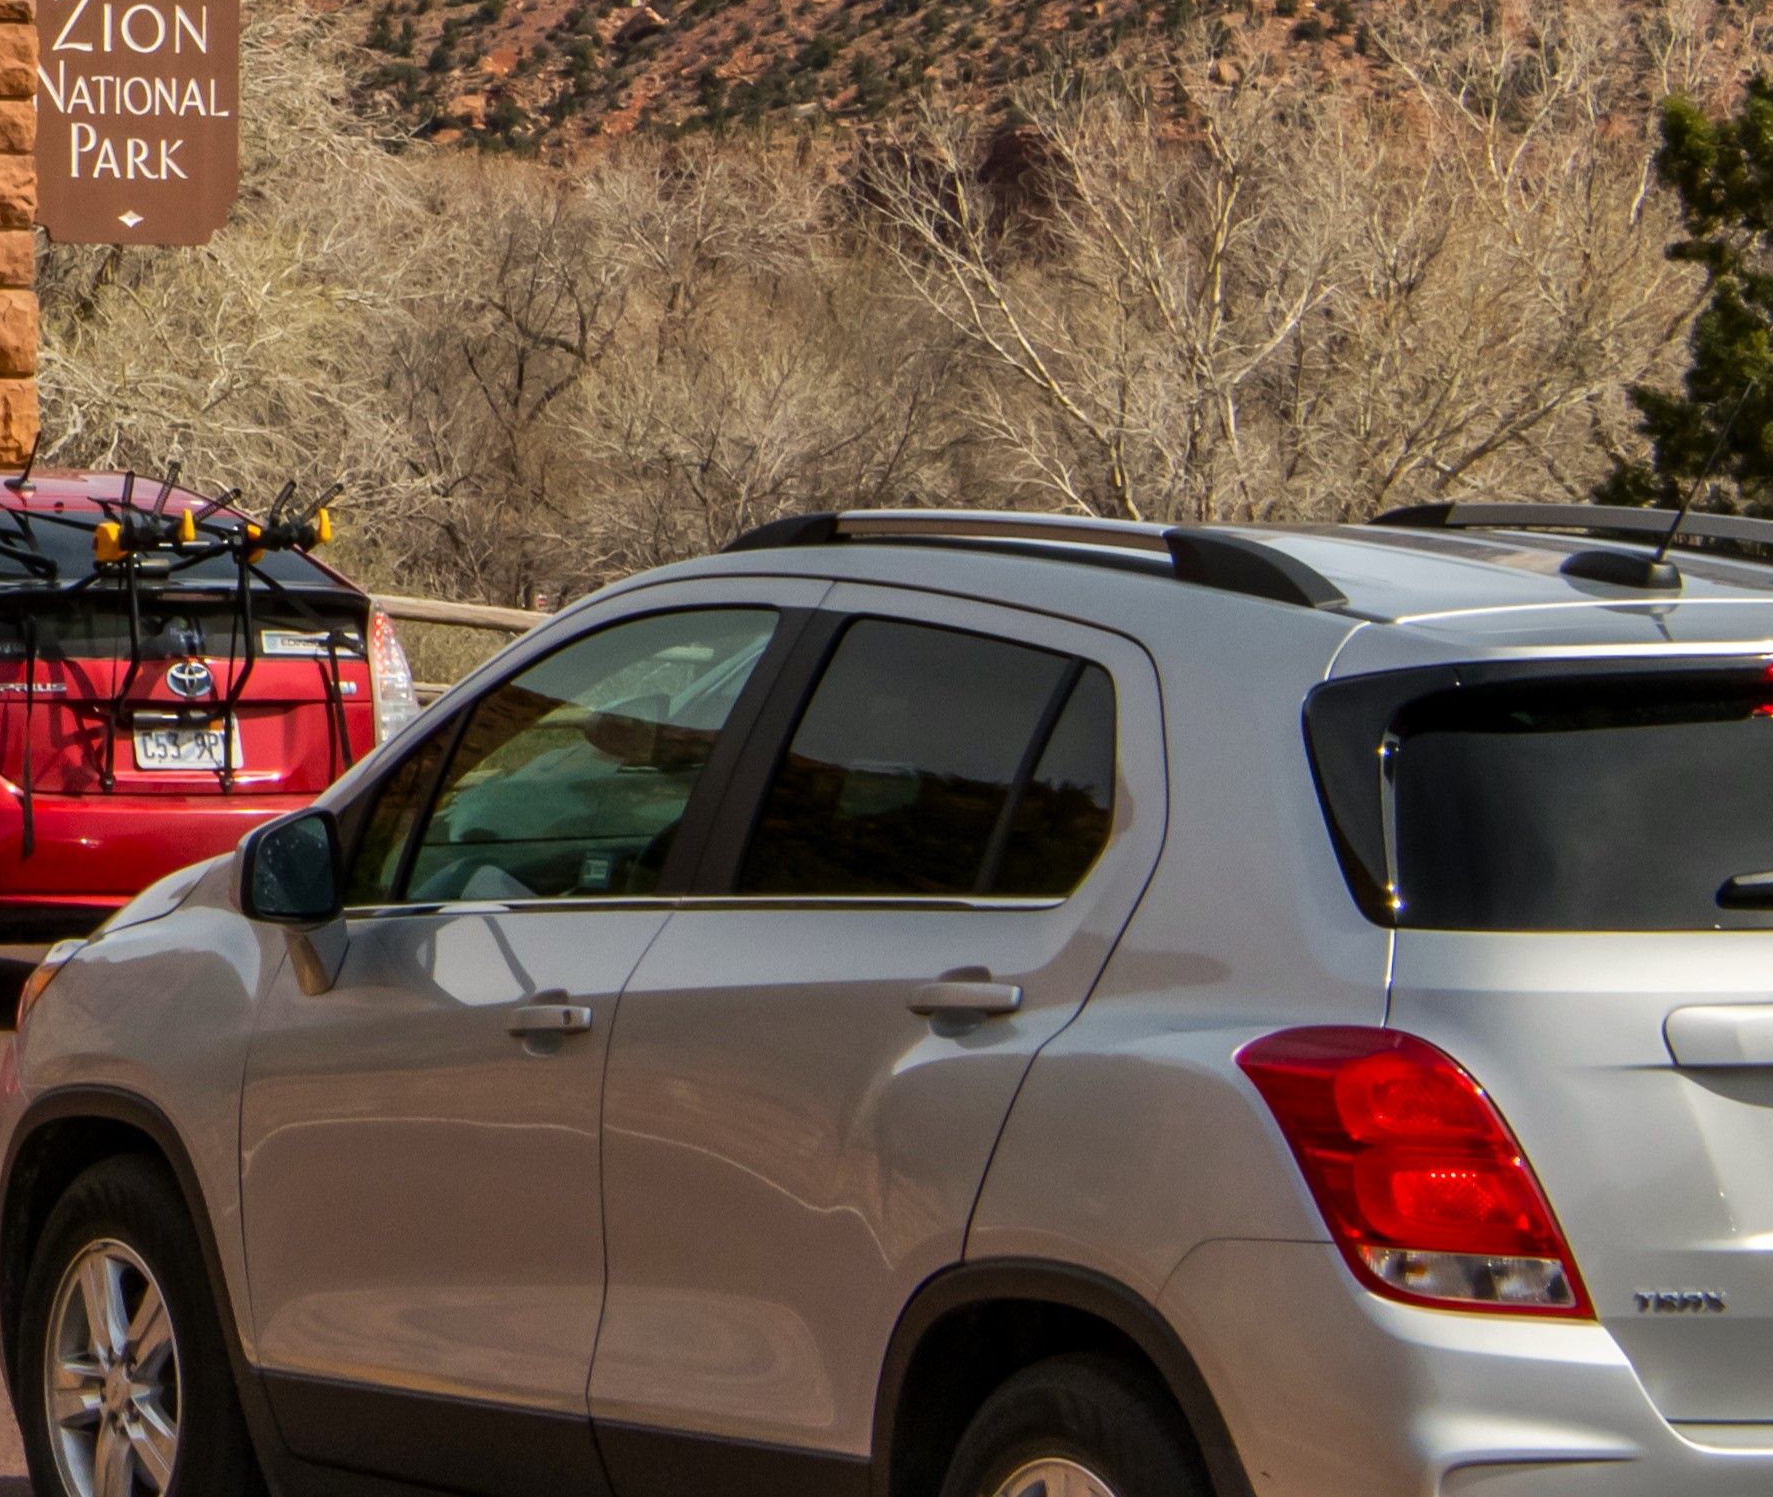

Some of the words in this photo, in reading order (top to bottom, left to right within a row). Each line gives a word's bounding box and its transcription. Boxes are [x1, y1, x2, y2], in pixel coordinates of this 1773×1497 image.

[33, 59, 230, 117] NATIONAL
[70, 122, 189, 180] PARK
[141, 730, 181, 759] C53
[194, 730, 225, 759] 9P
[1634, 1290, 1726, 1313] TRAX
